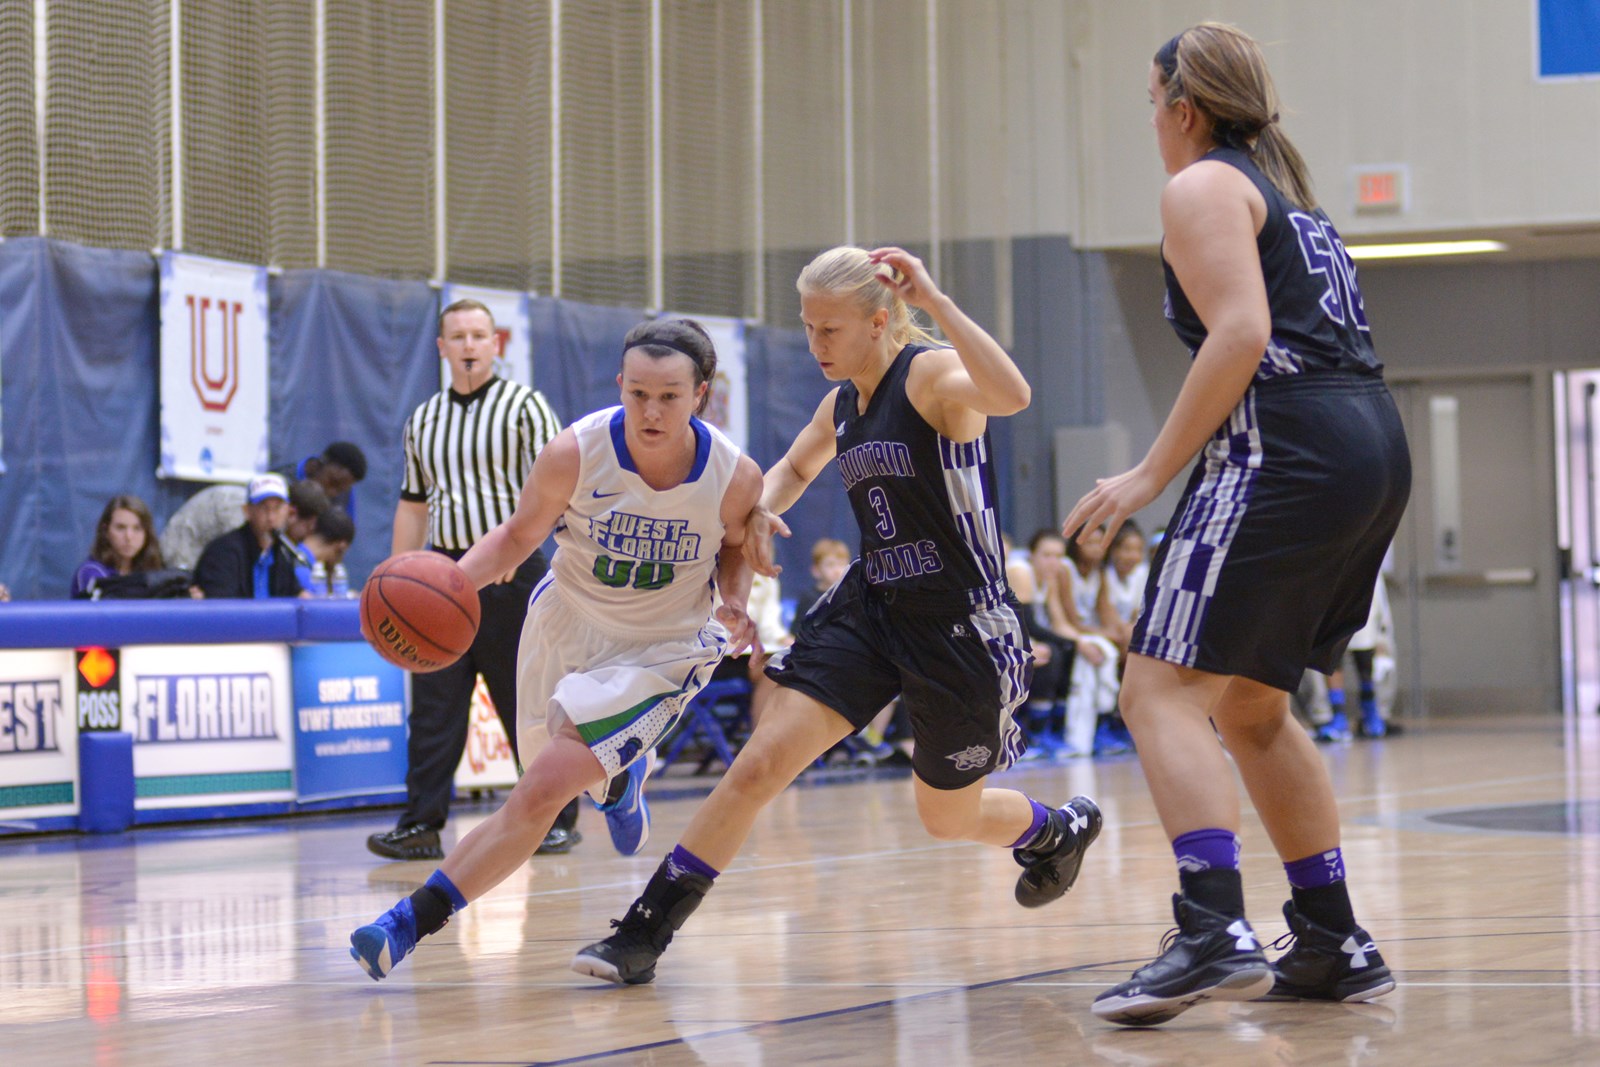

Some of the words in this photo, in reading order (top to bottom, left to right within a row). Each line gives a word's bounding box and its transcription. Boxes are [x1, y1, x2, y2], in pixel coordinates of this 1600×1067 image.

[186, 295, 243, 413] U
[837, 441, 915, 492] OUNTAIN
[610, 511, 689, 541] WEST
[868, 486, 897, 540] 3
[588, 517, 701, 562] FLORIDA
[866, 540, 943, 584] LIONS
[79, 690, 119, 728] POSS
[134, 673, 281, 743] FLORIDA
